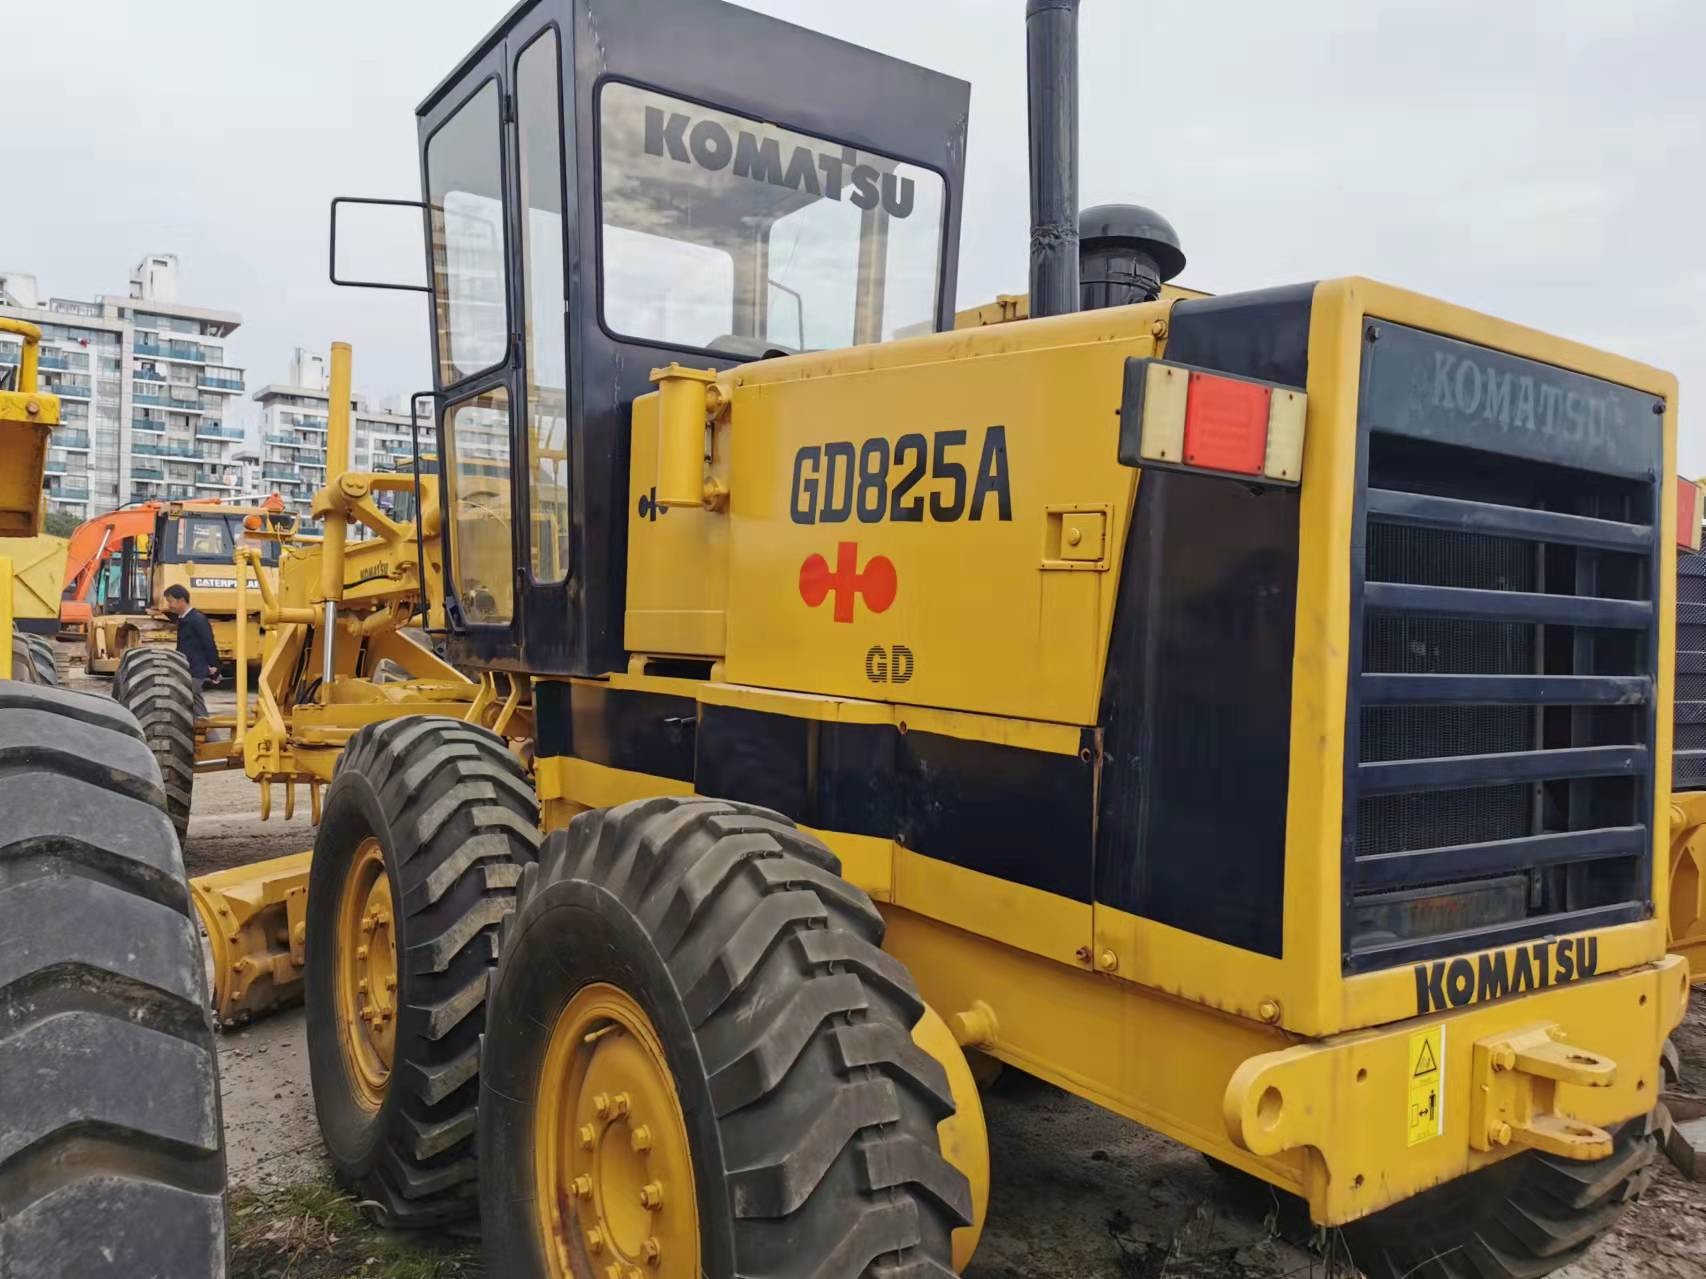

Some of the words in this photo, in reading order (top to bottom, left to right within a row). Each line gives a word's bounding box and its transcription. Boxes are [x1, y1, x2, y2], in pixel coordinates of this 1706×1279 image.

[644, 105, 915, 219] KOMATSU
[1432, 351, 1608, 447] KOMATSU
[790, 425, 1012, 525] GD825A
[865, 644, 914, 684] GD
[1414, 936, 1598, 1016] KOMATSU
